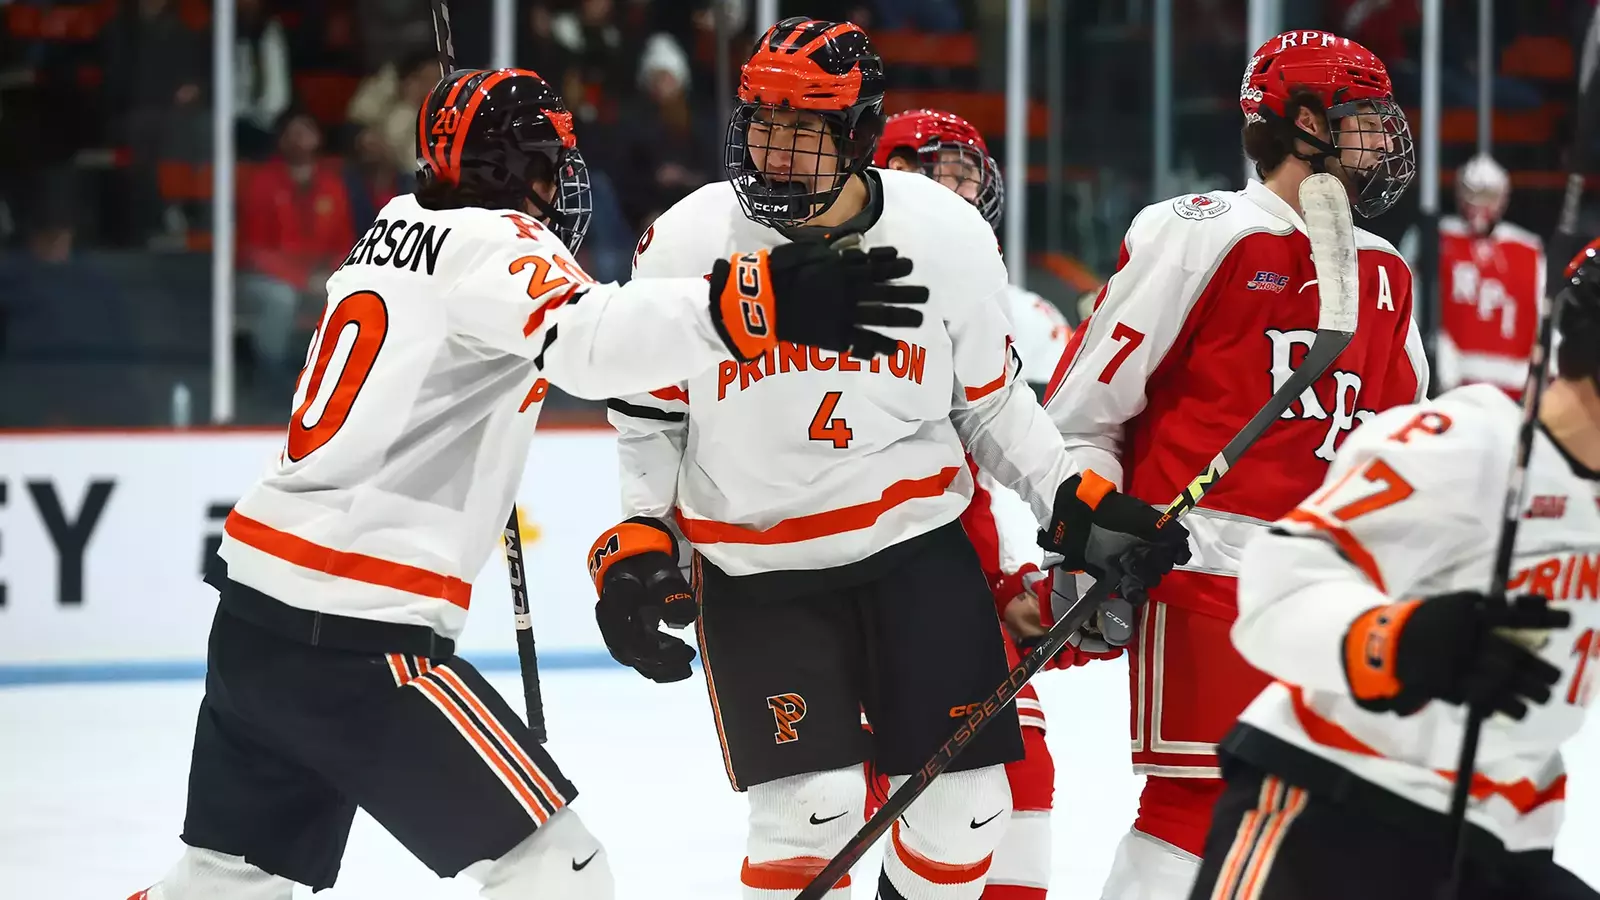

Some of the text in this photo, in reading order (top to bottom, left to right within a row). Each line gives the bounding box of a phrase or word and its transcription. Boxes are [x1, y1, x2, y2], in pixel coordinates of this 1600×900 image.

[432, 107, 461, 135] 20
[754, 202, 789, 212] CCM
[1377, 265, 1395, 312] A
[1098, 321, 1146, 385] 7
[808, 391, 853, 449] 4
[504, 527, 525, 615] CCM
[1105, 611, 1129, 629] CCM
[766, 693, 807, 744] P
[915, 667, 1027, 792] JETSPEED
